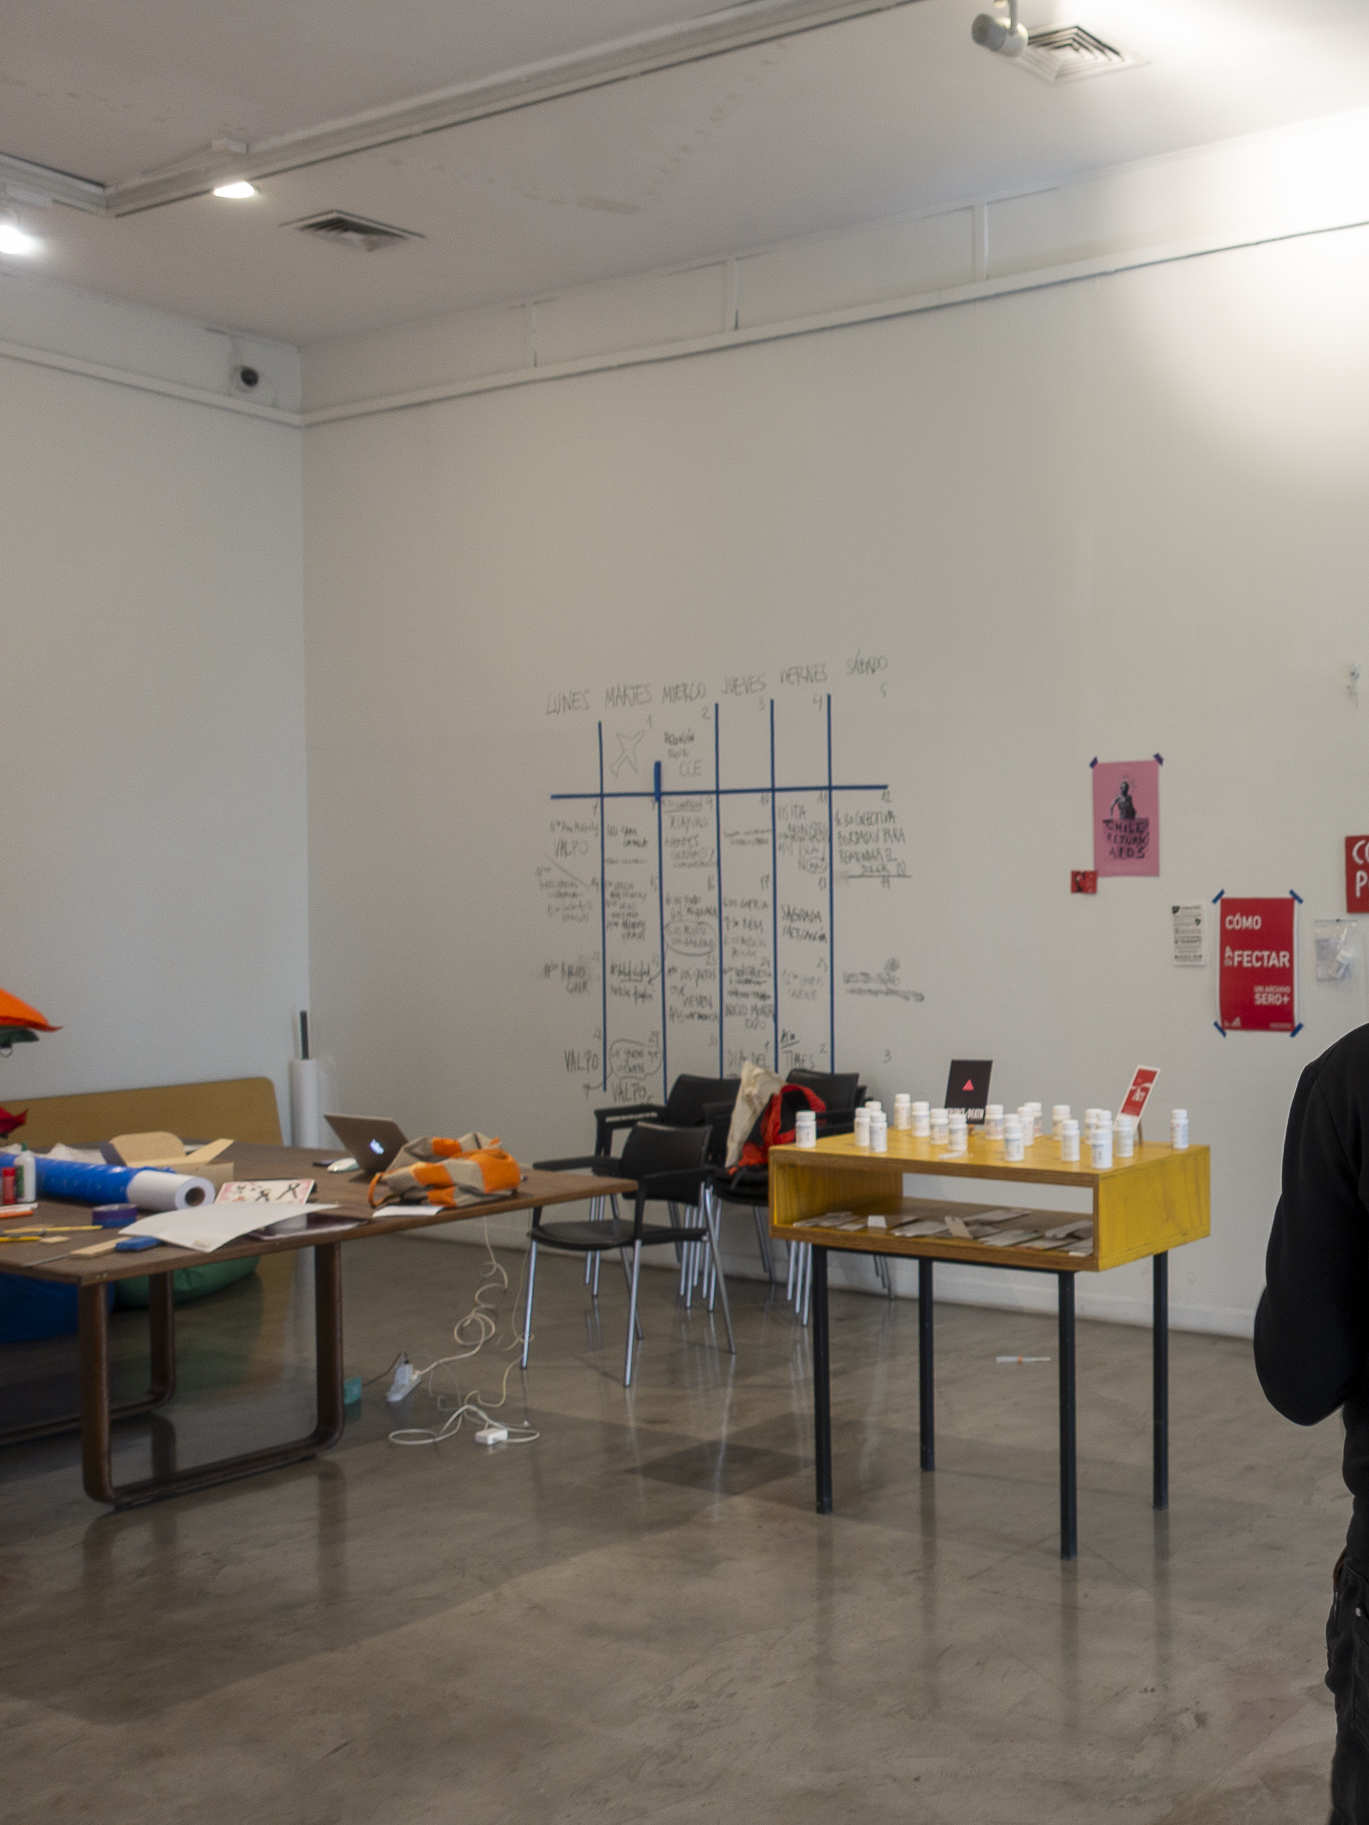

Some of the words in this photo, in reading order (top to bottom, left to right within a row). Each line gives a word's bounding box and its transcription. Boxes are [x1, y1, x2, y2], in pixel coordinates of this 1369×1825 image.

[546, 688, 590, 716] LUNES
[605, 681, 653, 708] MARTES
[720, 674, 767, 697] JUEVES
[1108, 846, 1146, 860] AIDS
[1225, 912, 1262, 930] CÓMO
[564, 1049, 599, 1074] VALPO
[611, 1081, 647, 1104] VALPO
